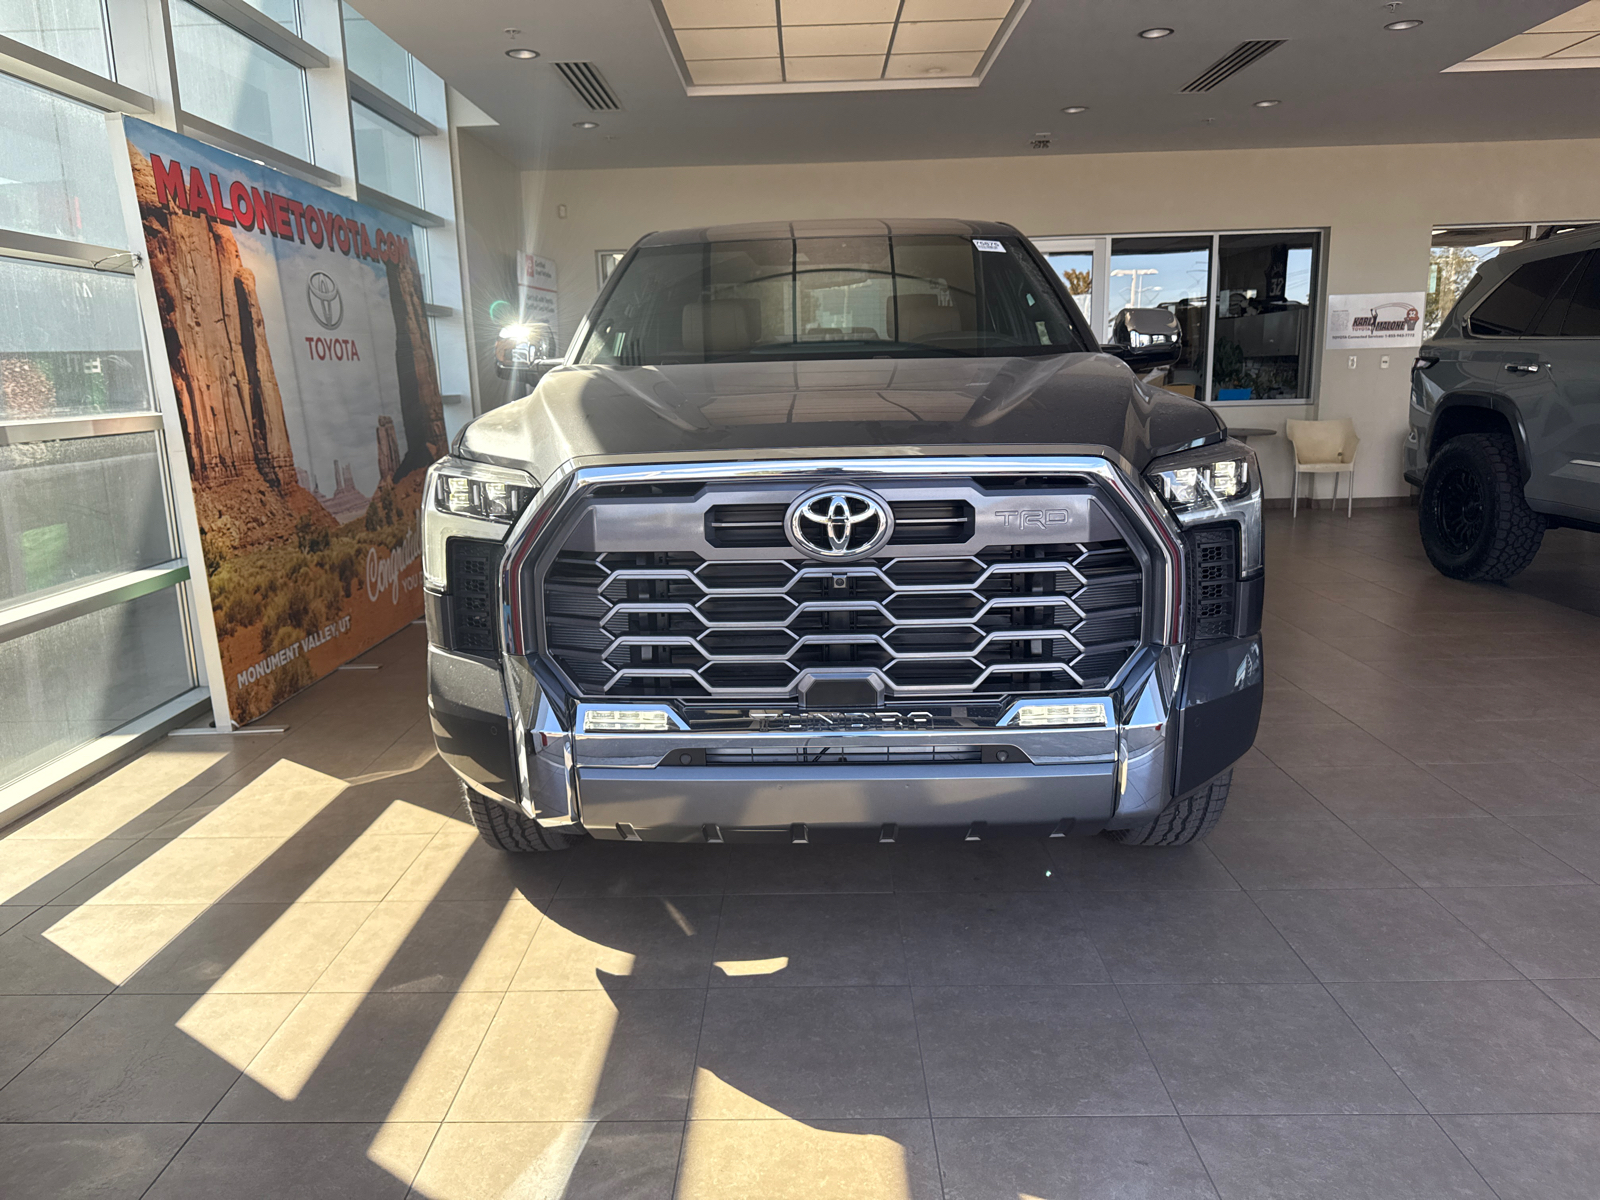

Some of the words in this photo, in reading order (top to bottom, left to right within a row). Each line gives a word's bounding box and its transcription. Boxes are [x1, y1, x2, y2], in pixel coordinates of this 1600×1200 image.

[150, 153, 411, 264] MALONETOYOTA.COM
[1270, 278, 1284, 296] 32
[1353, 317, 1373, 327] KARL
[1375, 321, 1405, 332] MALONE
[305, 337, 361, 362] TOYOTA
[995, 508, 1069, 530] TRD
[401, 574, 418, 593] YOU
[236, 643, 301, 689] MONUMENT
[300, 623, 340, 653] VALLEY,
[338, 615, 352, 634] UT
[750, 711, 935, 732] TUNDRA
